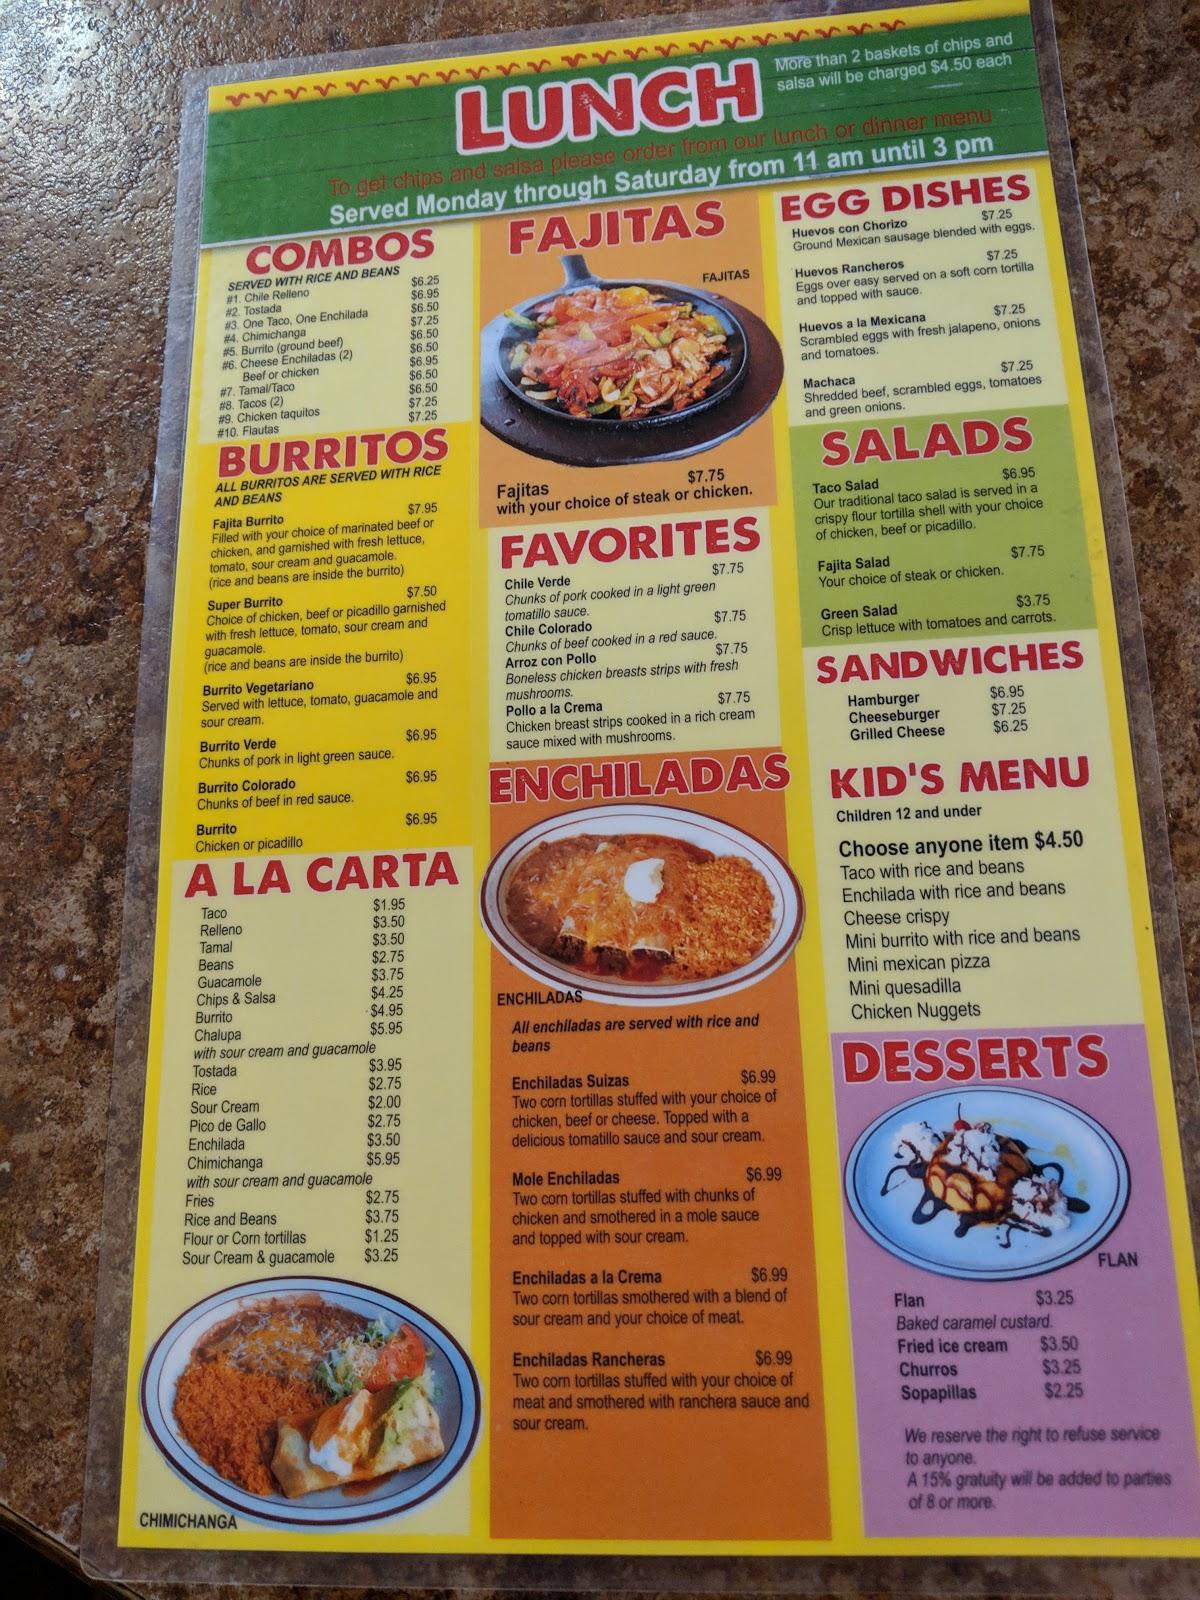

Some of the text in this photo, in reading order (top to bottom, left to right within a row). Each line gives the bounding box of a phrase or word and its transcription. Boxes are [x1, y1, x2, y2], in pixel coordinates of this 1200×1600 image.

[775, 32, 1012, 72] More than 2 baskets of chips and
[777, 53, 1012, 92] salsa will be charged $4.50 each
[457, 58, 762, 155] LUNCH
[330, 110, 992, 198] To get chips and salsa please order from our lunch or dinner menu
[330, 136, 994, 225] Served Monday through Saturday from 11 am until 3 pm
[781, 174, 1031, 222] EGG DISHES
[510, 200, 726, 255] FAJITAS
[793, 222, 1036, 251] Ground Mexican sausage blended with eggs.
[246, 229, 435, 275] COMBOS
[228, 265, 400, 292] SERVED WITH RICE AND BEANS
[703, 269, 749, 283] FAJITAS
[411, 301, 439, 314] $6.50
[225, 308, 368, 331] #3. One Taco, One Enchilada
[822, 416, 1033, 467] SALADS
[218, 427, 450, 478] BURRITOS
[688, 468, 724, 484] $7.75
[1003, 466, 1035, 481] $6.95
[496, 483, 549, 500] Fajitas
[812, 478, 880, 494] Taco Salad
[408, 502, 437, 516] $7.95
[497, 484, 752, 516] with your choice of steak or chicken.
[212, 518, 434, 544] Filled with your choice of marinated beef or
[213, 515, 284, 531] Fajita Burrito
[501, 516, 761, 569] FAVORITES
[822, 610, 1056, 638] Crisp lettuce with tomatoes and carrots.
[816, 640, 1084, 684] SANDWICHES
[718, 691, 750, 705] $7.75
[848, 694, 919, 707] Hamburger
[990, 685, 1024, 700] $6.95
[507, 701, 602, 717] Pollo a la Crema
[849, 709, 940, 724] Cheeseburger
[992, 702, 1026, 717] $7.25
[489, 753, 791, 804] ENCHILADAS
[830, 755, 1090, 799] KID'S MENU
[837, 804, 982, 823] Children 12 and under
[839, 830, 1083, 858] Choose anyone item $4.50
[184, 851, 459, 898] A LA CARTA
[846, 927, 1080, 949] Mini burrito with rice and beans
[197, 991, 275, 1009] Chips & Salsa
[371, 985, 403, 1000] $4.25
[498, 990, 582, 1006] ENCHILADAS
[194, 1041, 376, 1059] with sour cream and guacamole
[841, 1034, 1110, 1084] DESSERTS
[513, 1073, 629, 1090] Enchiladas Suizas
[741, 1069, 776, 1085] $6.99
[184, 1230, 306, 1246] Flour or Corn tortillas
[365, 1228, 398, 1244] $1.25
[1098, 1252, 1138, 1268] FLAN
[894, 1293, 924, 1307] Flan
[897, 1315, 938, 1331] Baked
[943, 1314, 996, 1331] caramel
[898, 1338, 1008, 1354] Fried ice cream
[1040, 1335, 1079, 1353] $3.50
[140, 1512, 237, 1529] CHIMICHANGA
